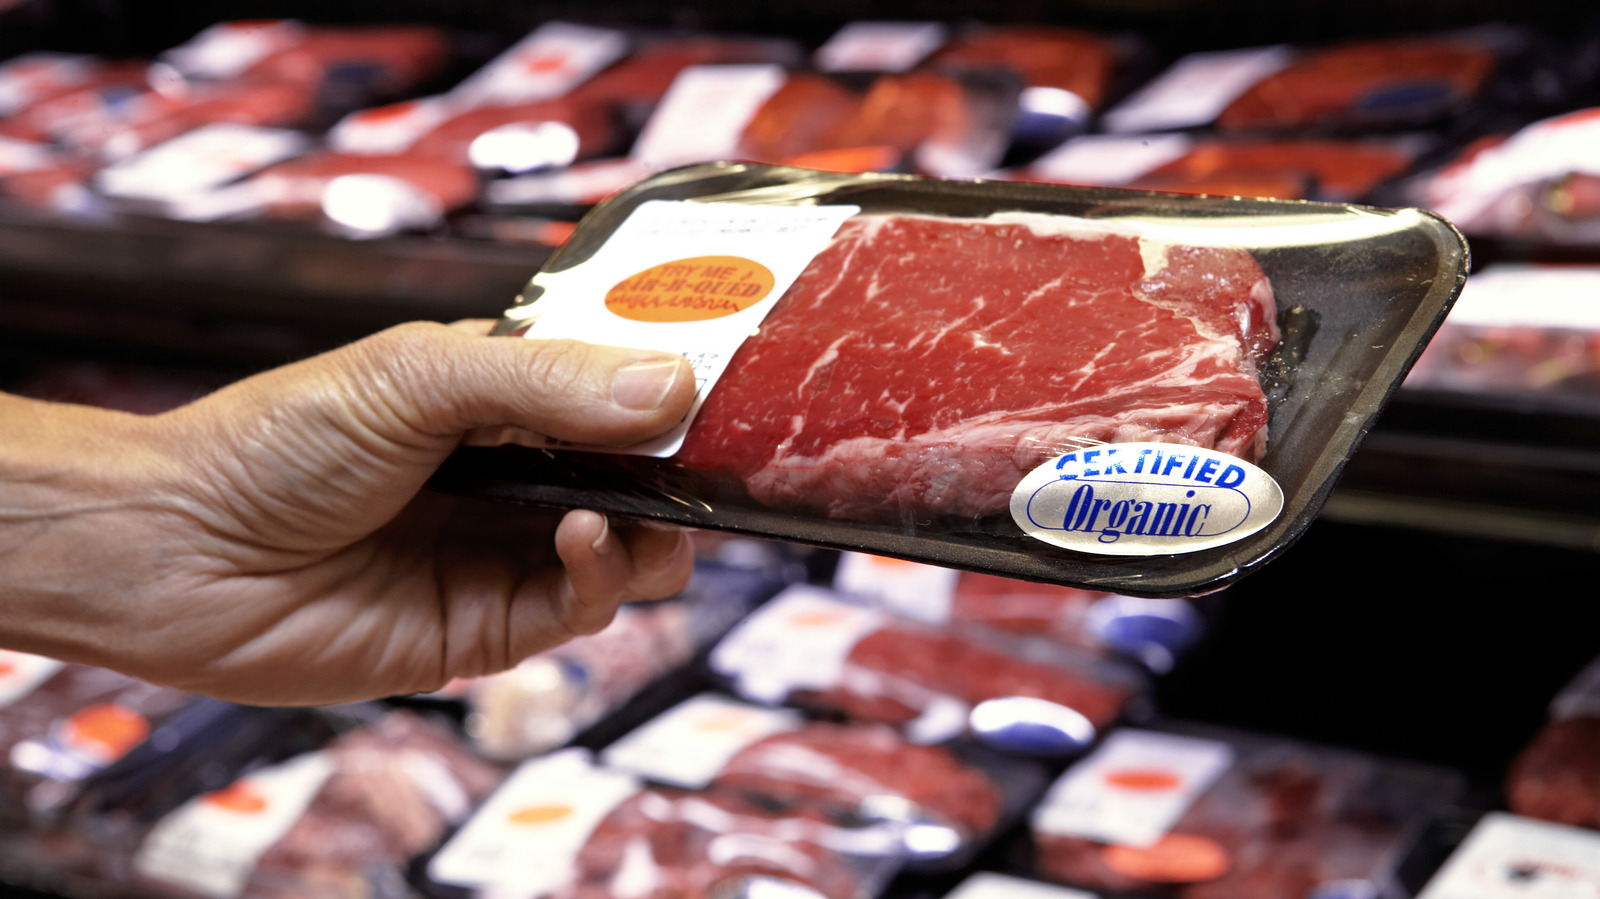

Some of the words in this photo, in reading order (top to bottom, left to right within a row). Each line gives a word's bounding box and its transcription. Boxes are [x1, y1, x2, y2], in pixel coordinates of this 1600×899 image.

[658, 264, 701, 278] TRY
[700, 265, 737, 279] ME
[1055, 448, 1246, 489] CERTIFIED
[1063, 483, 1212, 543] Organic
